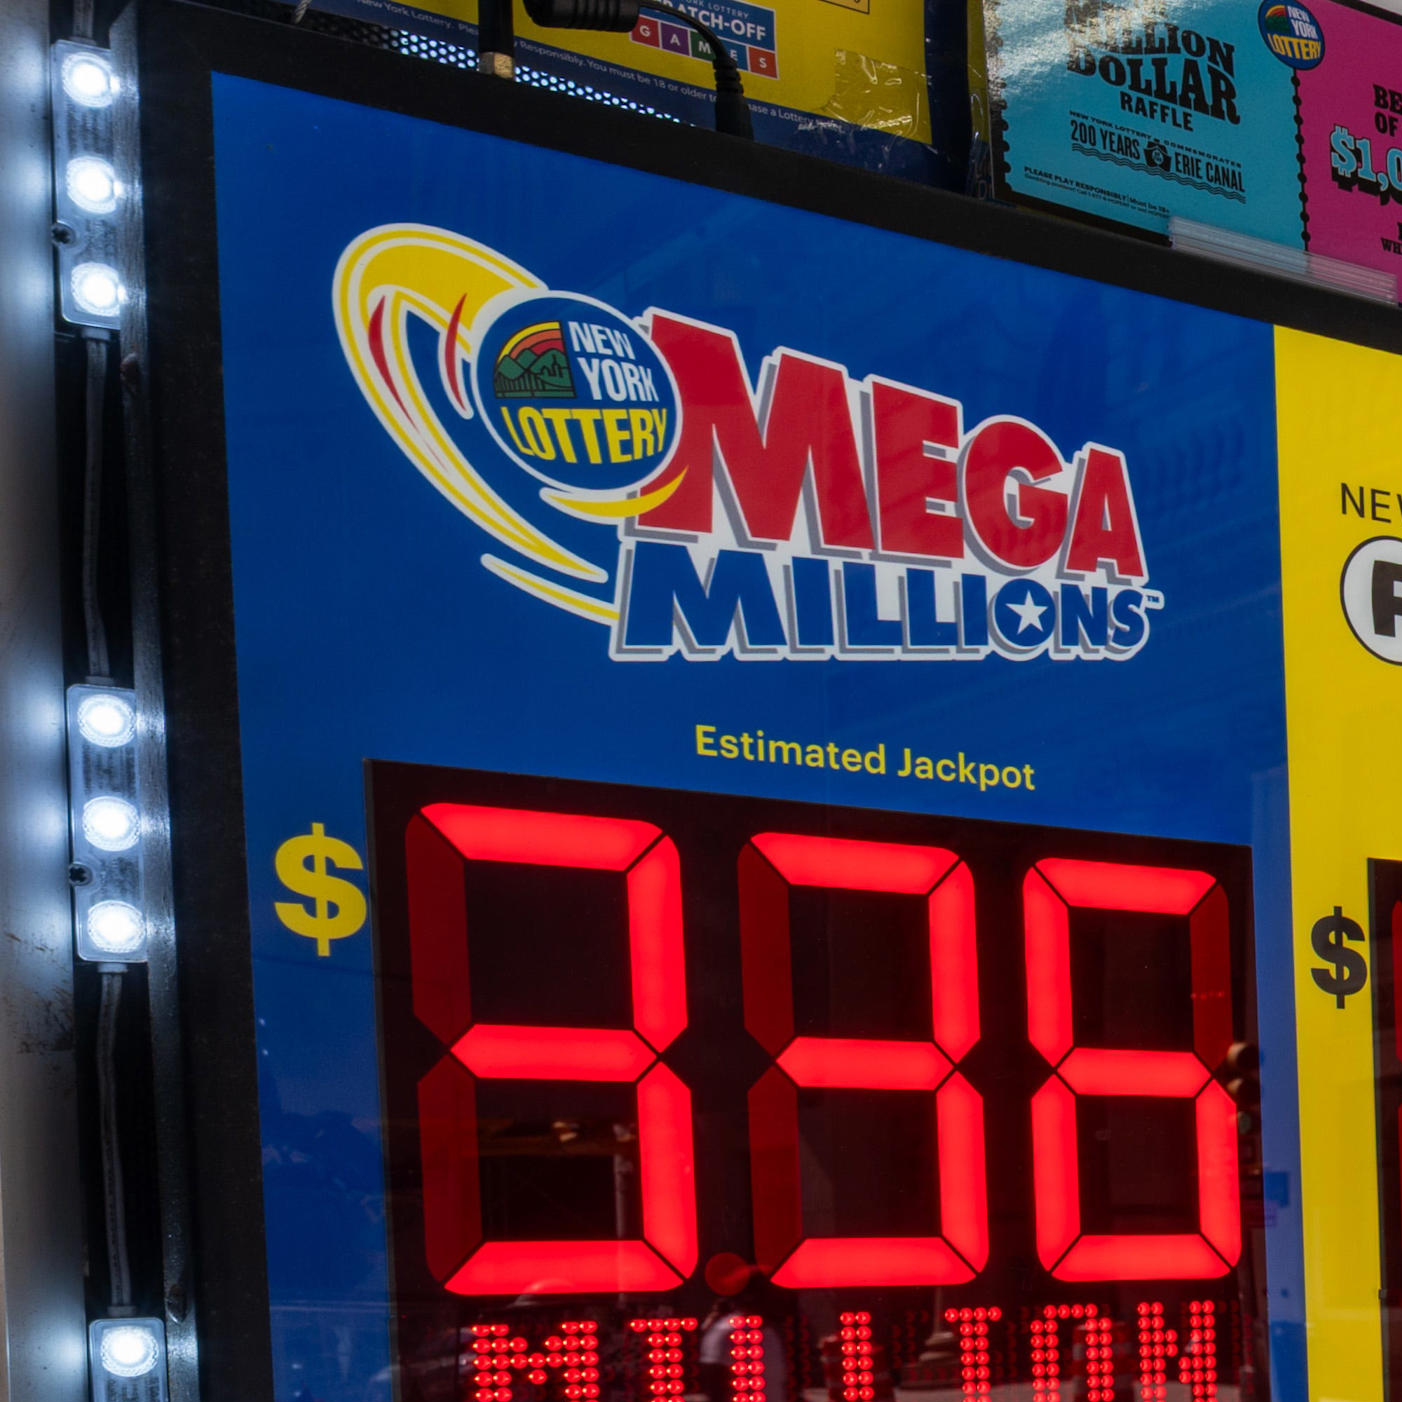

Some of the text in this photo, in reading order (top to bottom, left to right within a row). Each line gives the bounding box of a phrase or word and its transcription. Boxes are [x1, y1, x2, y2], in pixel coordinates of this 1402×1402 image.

[1066, 46, 1240, 124] DOLLAR
[1119, 91, 1193, 131] RAFFLE
[1070, 119, 1097, 147] 200
[1100, 126, 1141, 160] YEARS
[1174, 154, 1203, 180] ERIE
[1205, 161, 1246, 193] CANAL
[1374, 112, 1398, 137] OF
[568, 319, 635, 363] NEW
[576, 356, 660, 404] YORK
[500, 406, 669, 466] LOTTERY
[638, 312, 1147, 584] MEGA
[620, 546, 1149, 655] MILLIONS
[694, 723, 1037, 793] Estimated Jackpot
[274, 822, 367, 956] $
[1310, 904, 1370, 1010] $
[416, 801, 1243, 1297] 336
